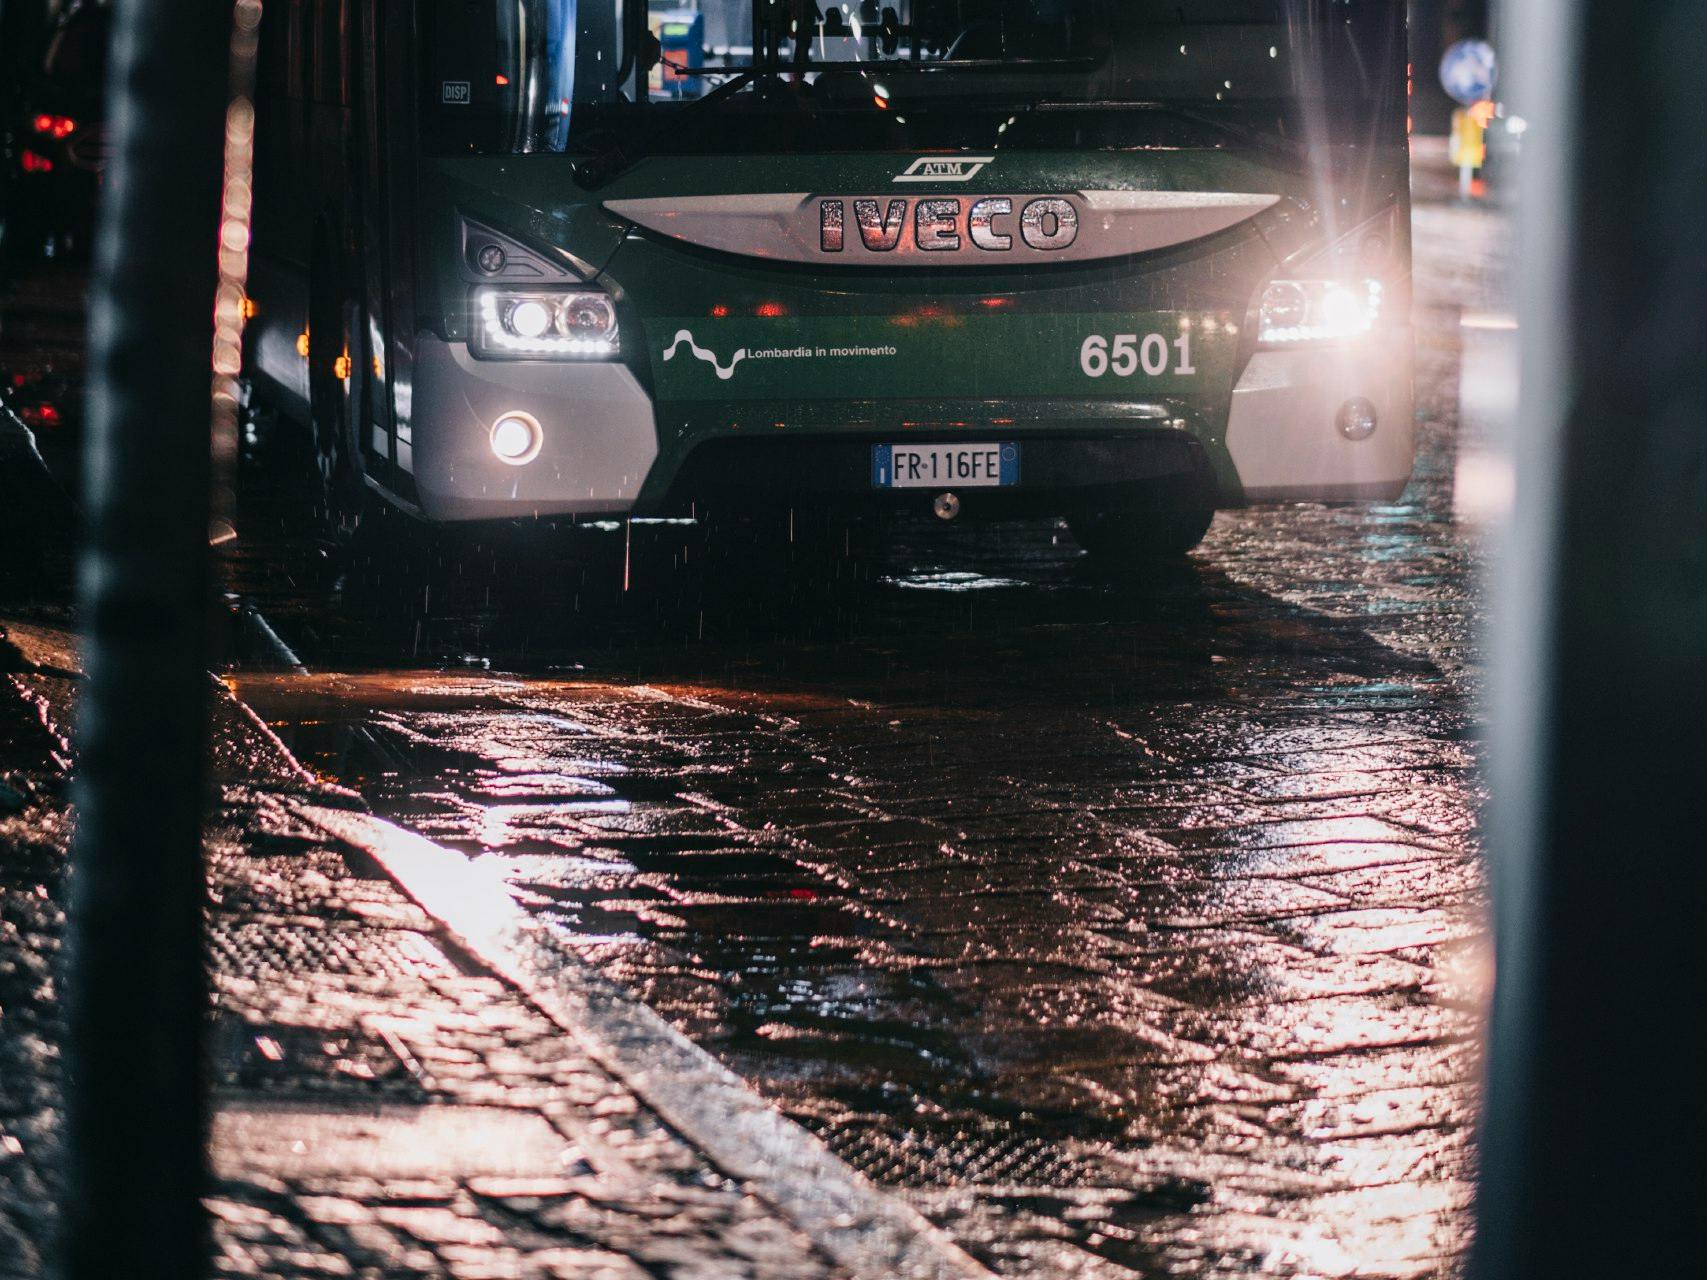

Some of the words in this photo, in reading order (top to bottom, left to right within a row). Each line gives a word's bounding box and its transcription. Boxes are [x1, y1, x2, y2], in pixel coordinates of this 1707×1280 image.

[445, 85, 467, 100] DISP
[923, 163, 963, 175] ATM
[820, 197, 1079, 252] IVECO
[748, 347, 812, 359] Lombardia
[815, 347, 826, 357] in
[830, 345, 897, 357] movimento
[1080, 333, 1196, 377] 6501
